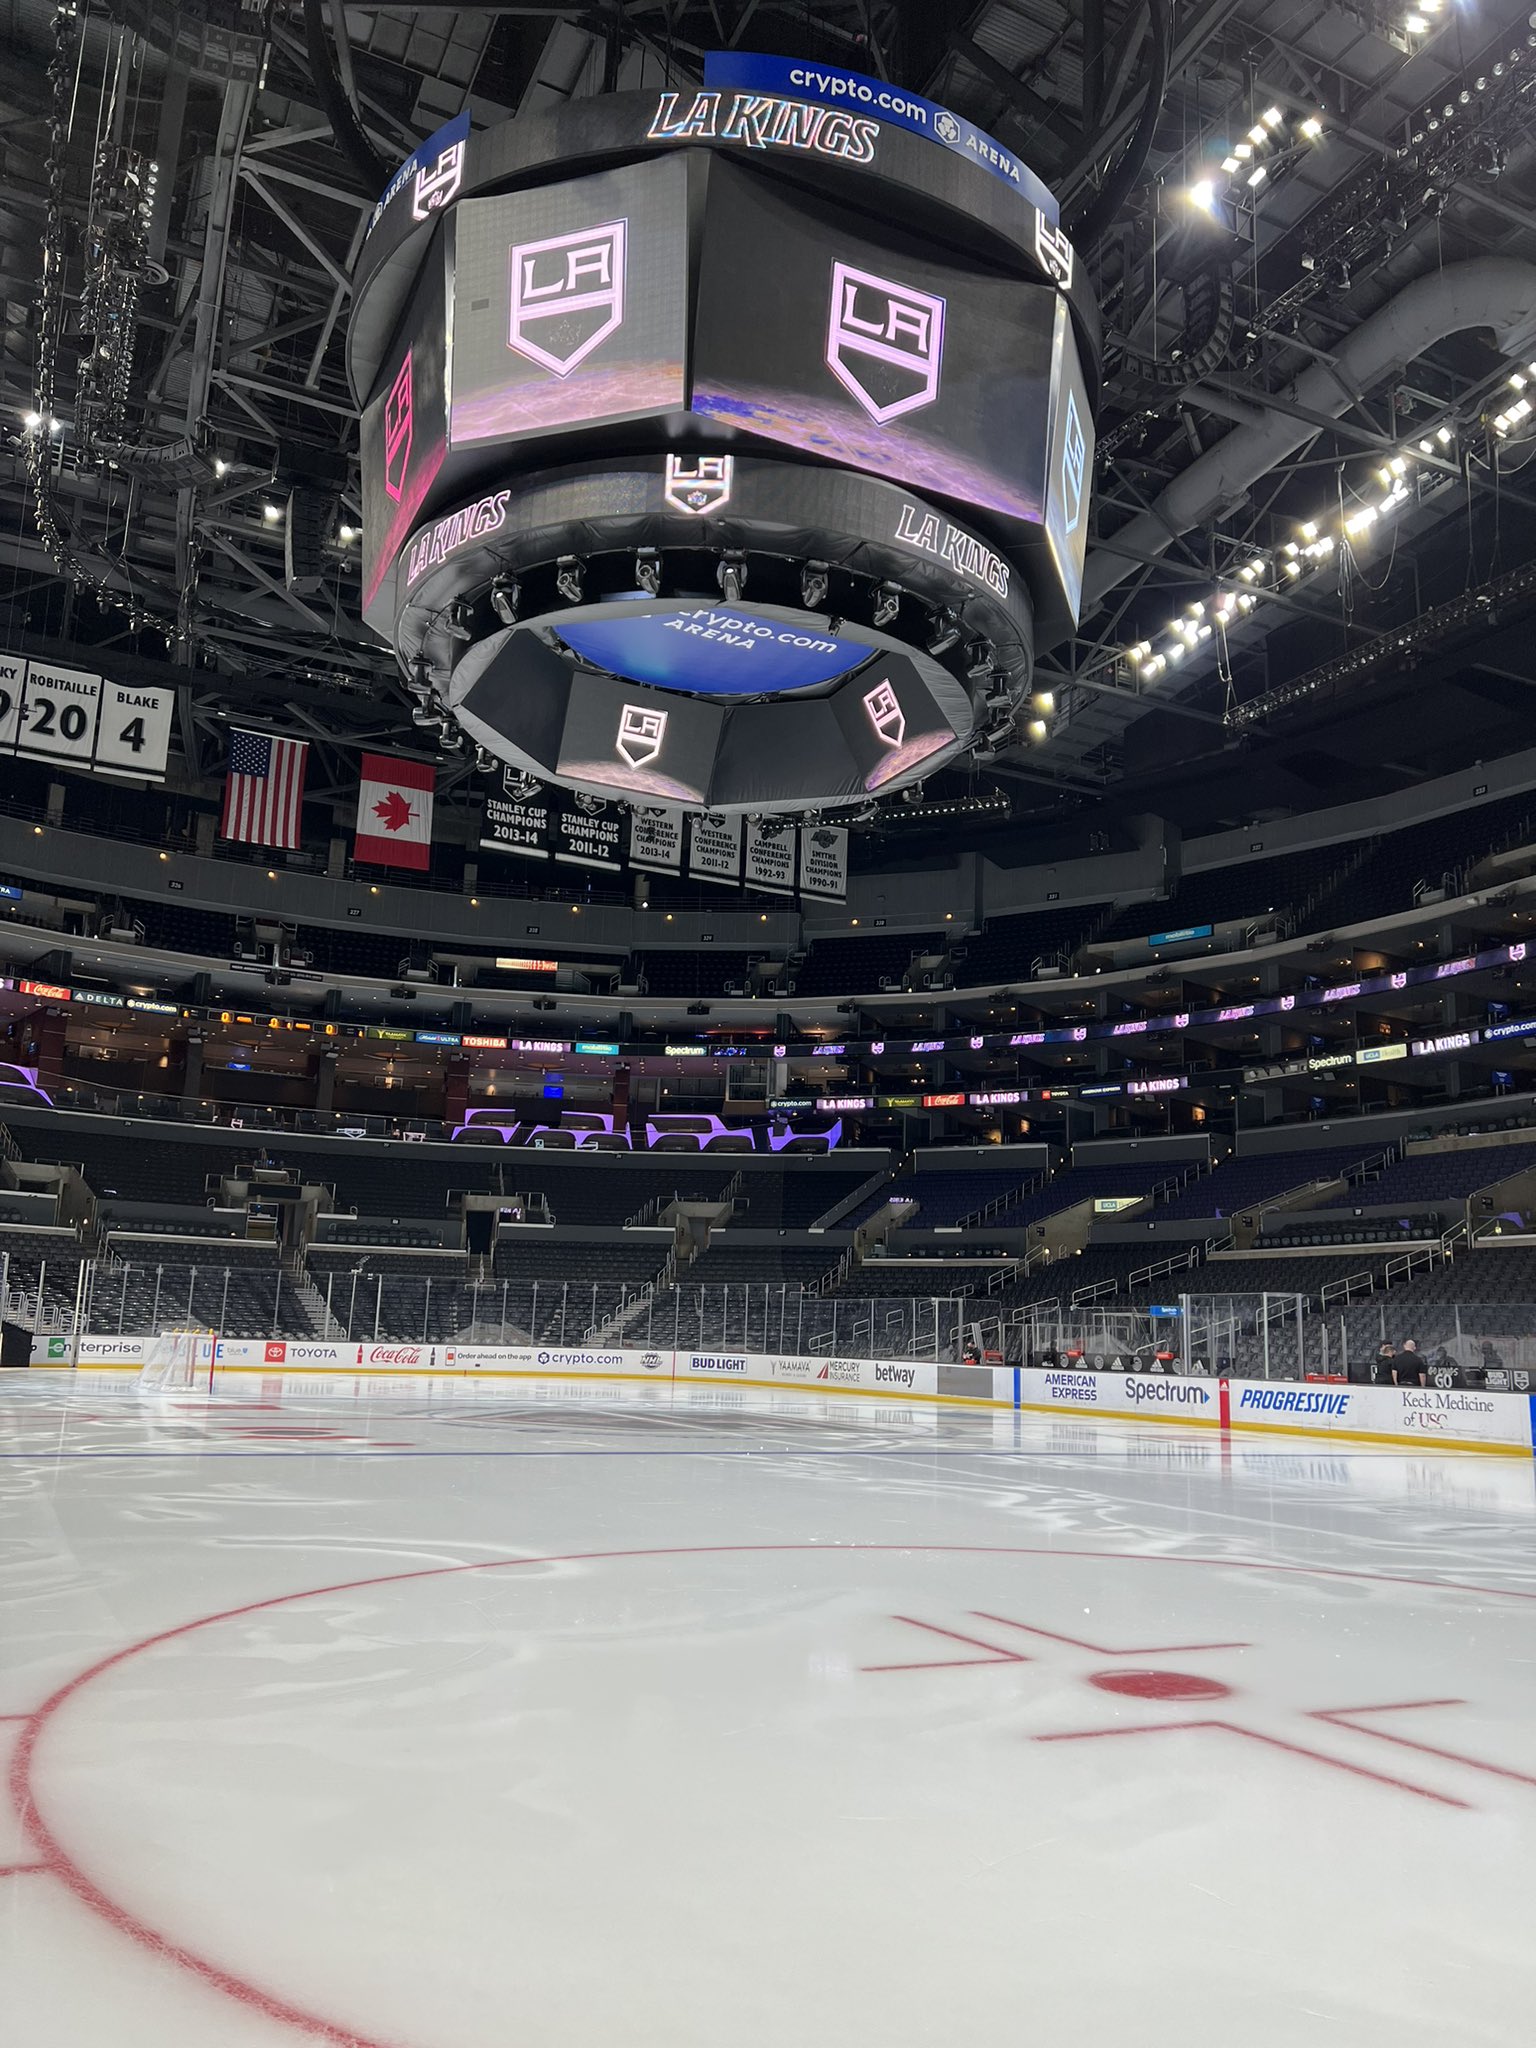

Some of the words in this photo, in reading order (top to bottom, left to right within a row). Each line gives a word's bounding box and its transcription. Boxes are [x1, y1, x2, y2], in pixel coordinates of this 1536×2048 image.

[647, 92, 722, 138] LA
[721, 94, 880, 164] KINGS
[790, 68, 927, 124] crypto.com
[965, 134, 1021, 183] ARENA
[420, 144, 459, 189] LA
[384, 159, 418, 211] ARENA
[1041, 211, 1070, 261] LA
[522, 243, 612, 300] LA
[842, 283, 931, 353] LA
[673, 456, 724, 478] LA
[428, 489, 511, 564] KINGS
[895, 504, 941, 554] LA
[941, 524, 1010, 599] KINGS
[664, 618, 755, 650] ARENA
[30, 673, 98, 697] ROBITAILLE
[117, 691, 160, 710] BLAKE
[29, 698, 88, 742] 20
[624, 713, 661, 736] LA
[119, 717, 146, 753] 4
[487, 799, 526, 816] STANLEY
[528, 807, 548, 818] CUP
[486, 809, 547, 829] CHAMPIONS
[561, 813, 600, 830] STANLEY
[601, 821, 619, 832] CUP
[641, 818, 674, 831] WESTERN
[493, 825, 539, 845] 2013-14
[560, 823, 619, 843] CHAMPIONS
[701, 828, 733, 842] WESTERN
[569, 839, 610, 857] 2011-12
[694, 836, 738, 851] CONFERENCE
[754, 839, 788, 852] CAMPBELL
[640, 846, 670, 859] 2013-14
[696, 845, 735, 859] CHAMPIONS
[750, 846, 792, 861] CONFERENCE
[701, 857, 729, 869] 2011-12
[751, 855, 790, 869] CHAMPIONS
[810, 858, 839, 870] DIVISION
[755, 866, 785, 880] 1992-93
[805, 866, 842, 878] CHAMPIONS
[809, 876, 838, 889] 1990-91
[87, 994, 123, 1006] DELTA
[135, 1000, 177, 1013] crypto.com
[463, 1037, 506, 1048] TOSHIBA
[519, 1041, 533, 1051] LA
[533, 1041, 564, 1053] KINGS
[1420, 1039, 1435, 1055] LA
[1435, 1033, 1471, 1051] KINGS
[664, 1045, 704, 1056] Spectrum
[1309, 1055, 1352, 1070] Spectrum
[1134, 1082, 1148, 1093] LA
[1149, 1079, 1180, 1092] KINGS
[777, 1100, 812, 1108] crypto.com
[823, 1099, 838, 1109] LA
[839, 1098, 866, 1109] KINGS
[976, 1094, 990, 1104] LA
[991, 1092, 1020, 1104] KINGS
[291, 1348, 337, 1359] TOYOTA
[457, 1352, 477, 1360] Order
[477, 1352, 497, 1360] ahead
[508, 1352, 519, 1360] the
[519, 1354, 532, 1362] app
[552, 1353, 623, 1365] crypto.com
[692, 1357, 716, 1369] BUD
[717, 1358, 746, 1371] LIGHT
[829, 1361, 860, 1372] MERCURY
[829, 1372, 860, 1383] INSURANCE
[875, 1363, 915, 1388] betway
[1045, 1373, 1097, 1388] AMERICAN
[1434, 1374, 1453, 1388] GO
[1052, 1387, 1098, 1401] EXPRESS
[1126, 1377, 1205, 1404] Spectrum
[1240, 1389, 1350, 1415] PROGRESSIVE
[1402, 1391, 1433, 1409] Keck
[1435, 1393, 1494, 1412] Medicine
[1404, 1411, 1419, 1428] of
